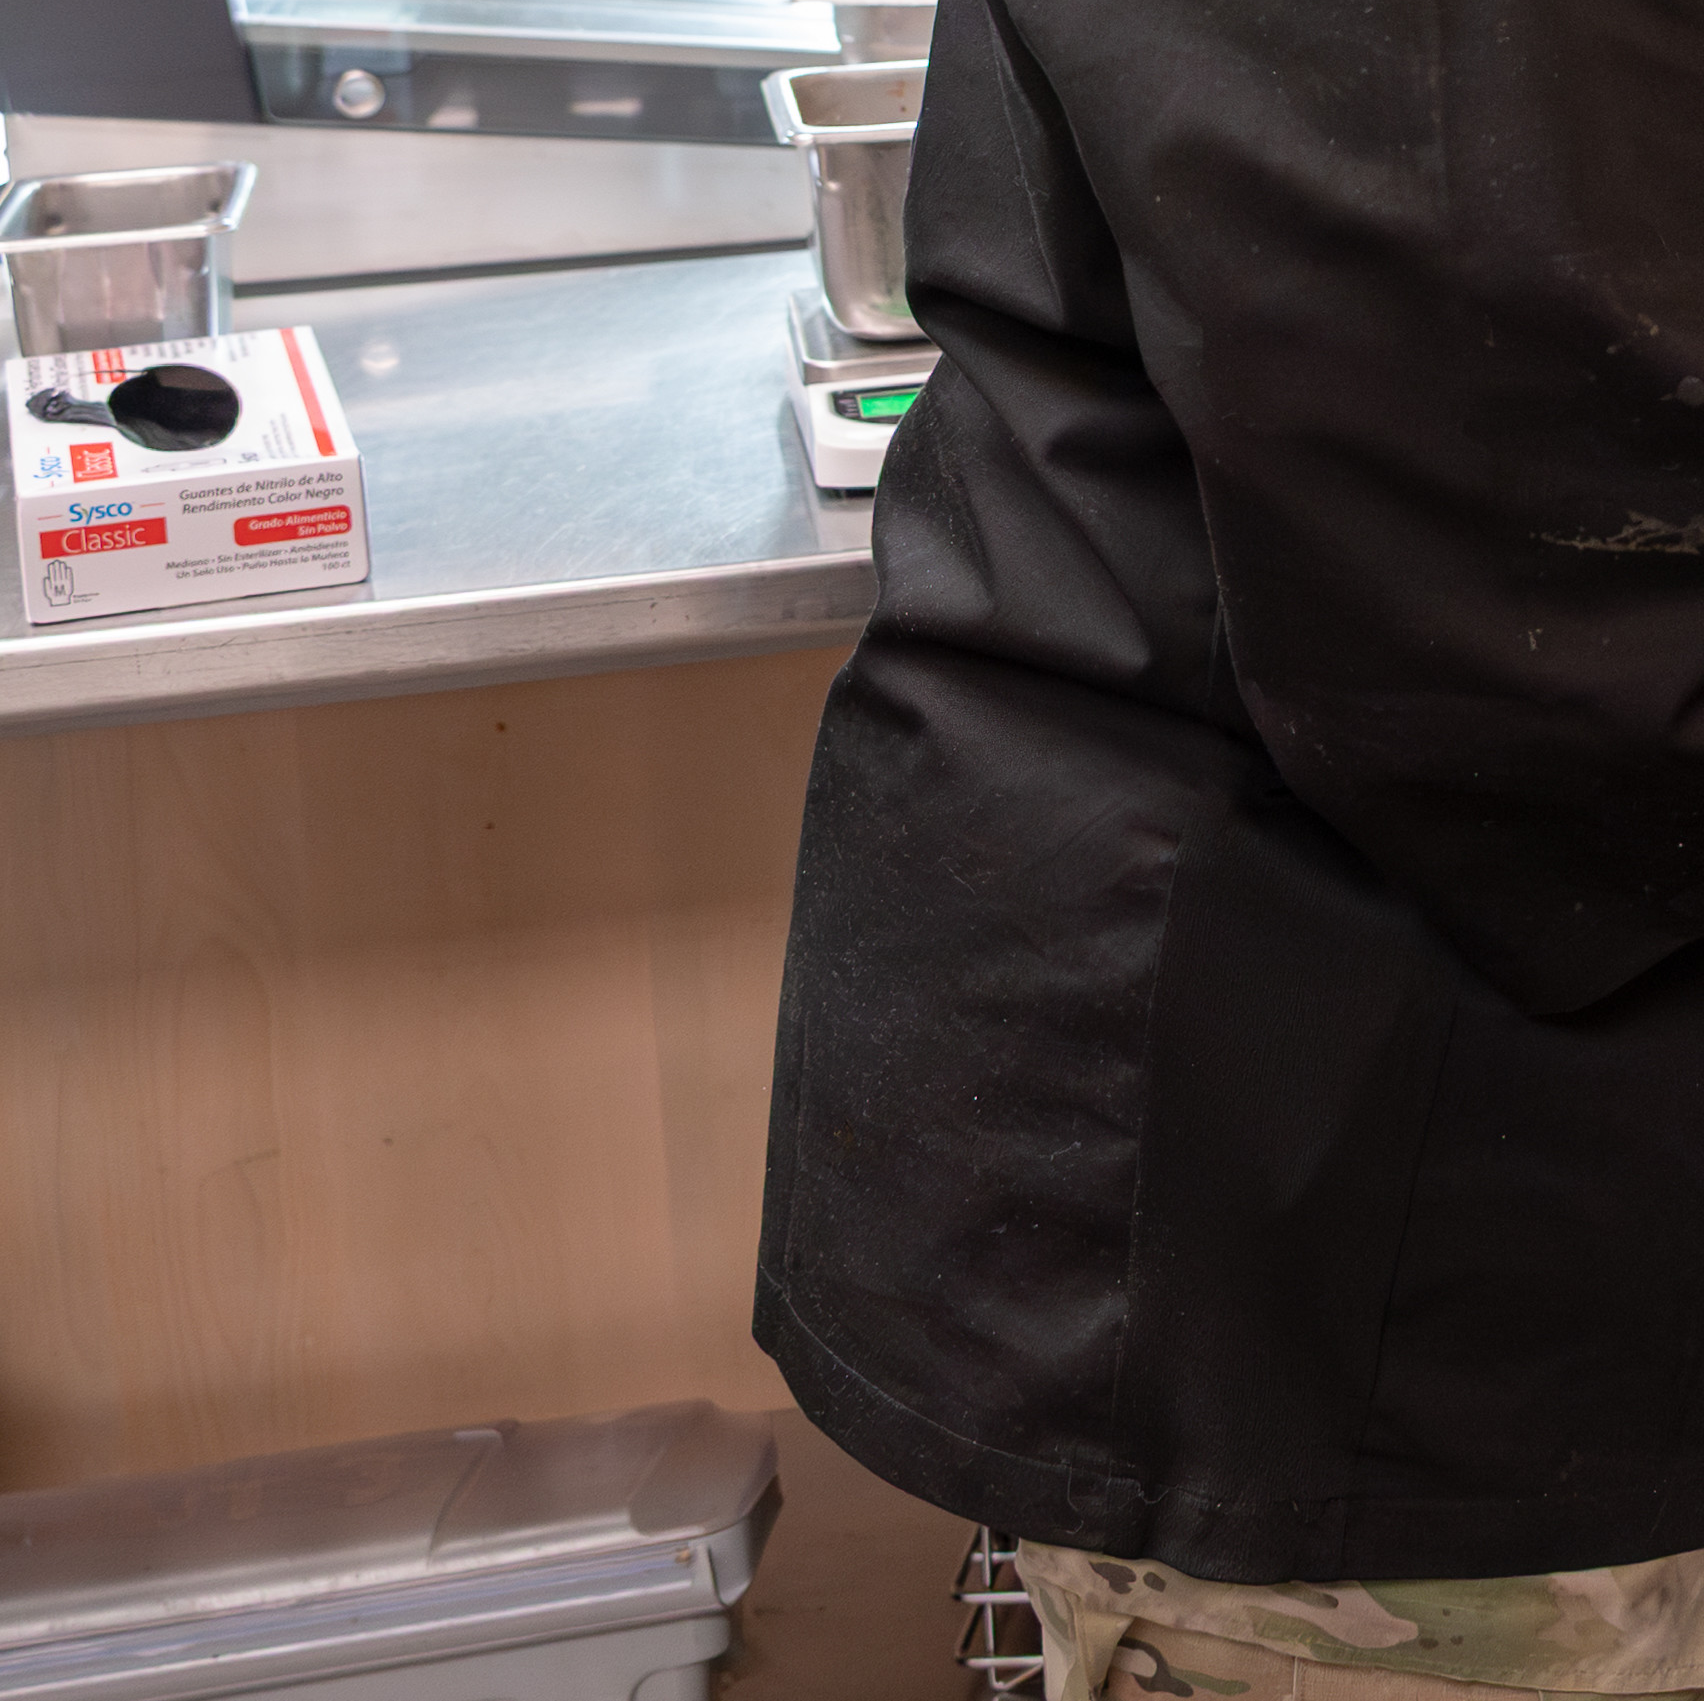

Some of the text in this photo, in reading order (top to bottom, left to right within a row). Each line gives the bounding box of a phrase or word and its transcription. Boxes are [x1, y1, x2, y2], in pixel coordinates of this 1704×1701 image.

[32, 456, 70, 479] Sysco
[76, 449, 114, 479] Classic
[178, 472, 344, 501] Guantes de Nitrilo de Alto
[182, 486, 345, 515] Rendimiento Color Negro
[68, 502, 133, 525] Sysco
[248, 509, 348, 531] Grado Alimenticio
[61, 524, 147, 554] Classic
[297, 525, 316, 537] Sin
[217, 554, 233, 564] Sin
[321, 560, 341, 572] 100
[54, 584, 67, 597] M
